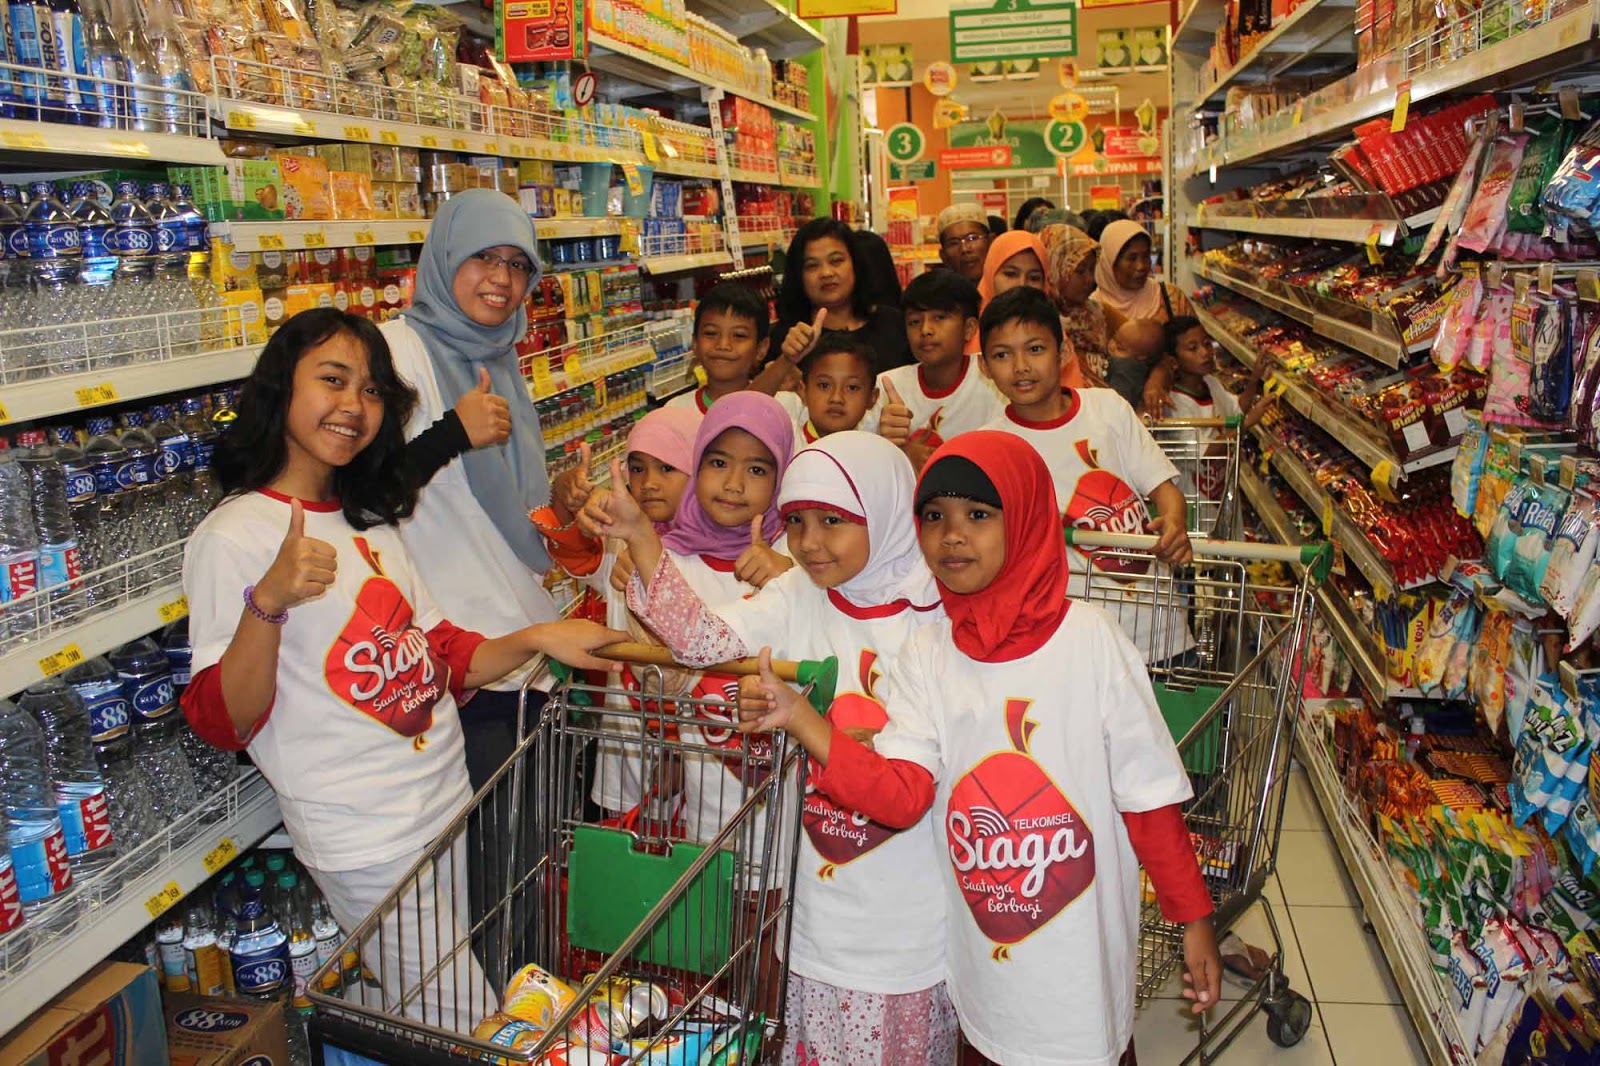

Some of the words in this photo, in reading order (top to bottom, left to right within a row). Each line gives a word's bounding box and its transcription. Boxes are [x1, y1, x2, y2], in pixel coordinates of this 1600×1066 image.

[897, 133, 912, 154] 3
[1059, 125, 1074, 147] 2
[128, 233, 149, 248] 88
[75, 475, 95, 494] 88
[372, 681, 418, 712] Saatnya
[101, 702, 129, 730] 88
[1013, 812, 1074, 830] TELKOMSEL
[950, 810, 1089, 898] Siaga
[962, 875, 1015, 900] Saatnya
[254, 961, 282, 985] 88
[180, 1009, 225, 1030] 88
